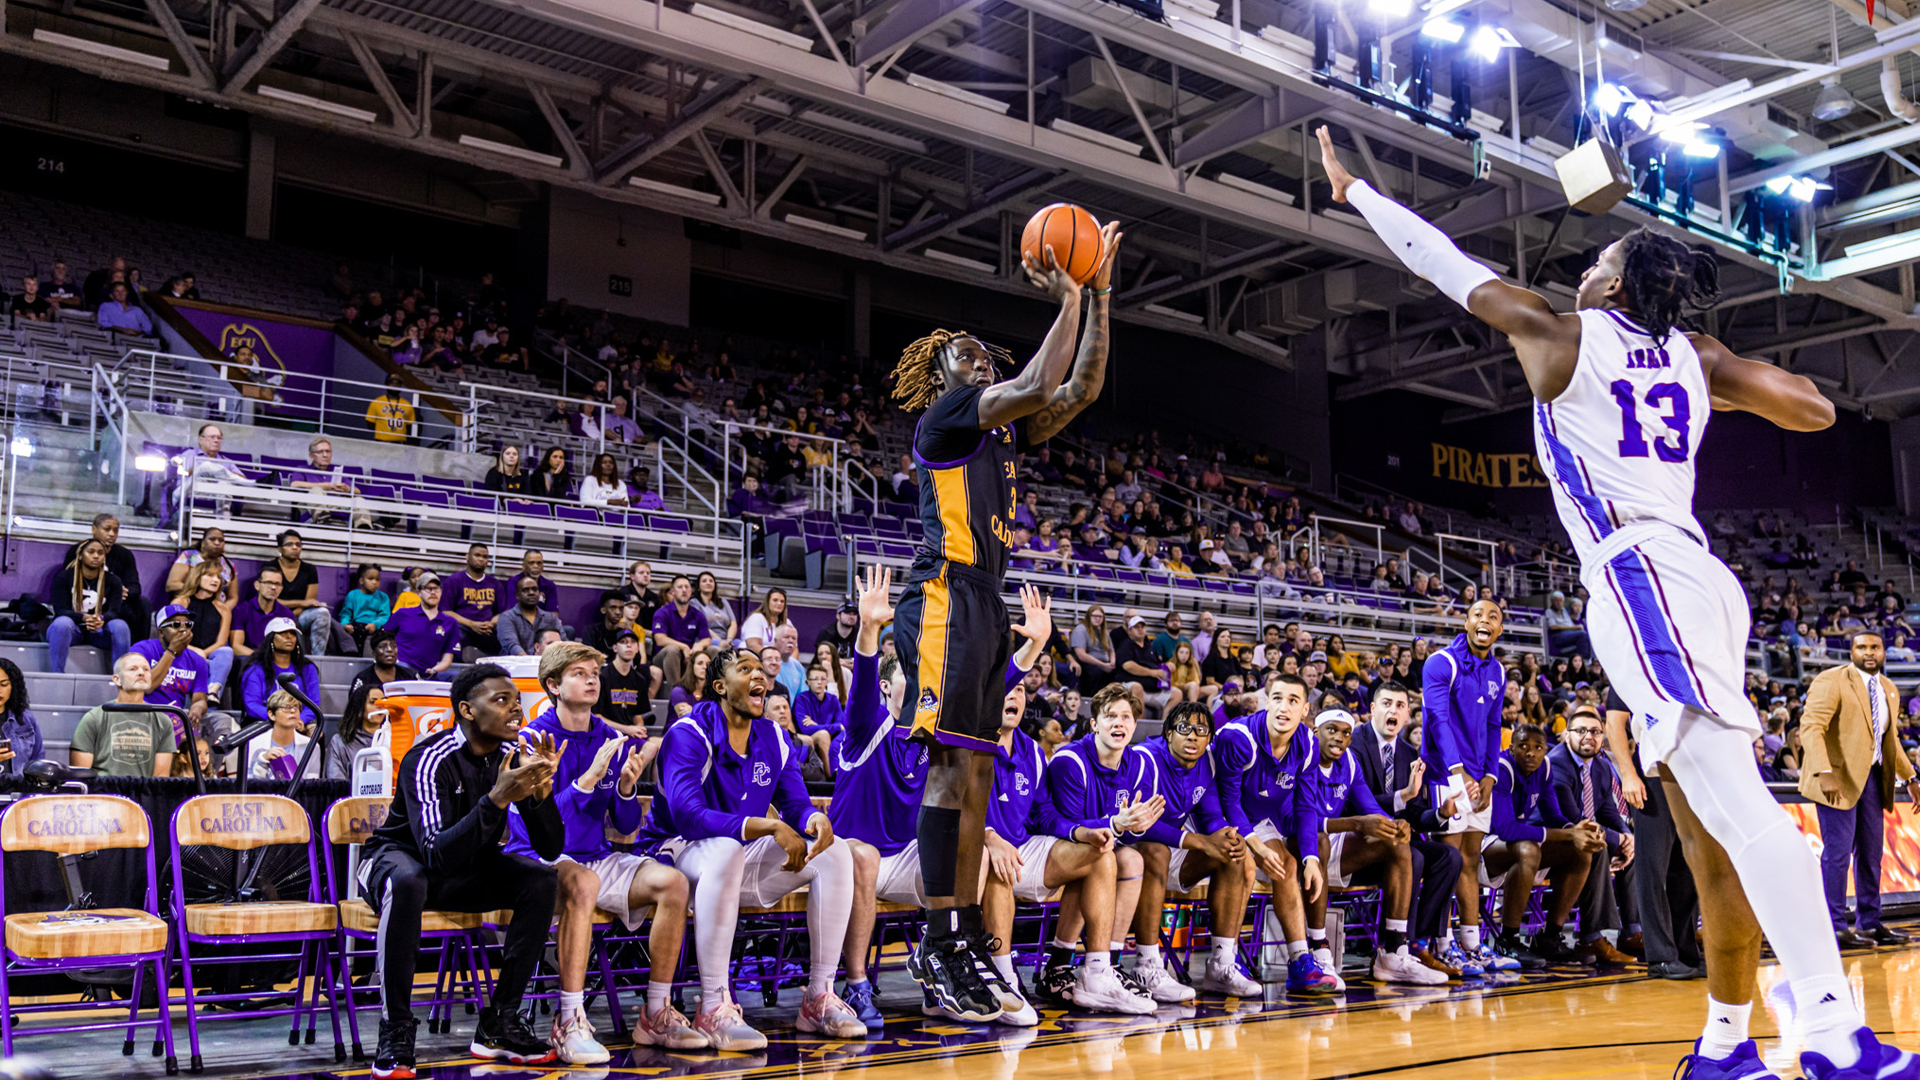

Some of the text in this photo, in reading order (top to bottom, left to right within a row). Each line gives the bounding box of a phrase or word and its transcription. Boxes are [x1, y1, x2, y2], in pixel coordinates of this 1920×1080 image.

[38, 157, 65, 173] 214
[230, 336, 256, 349] ECU
[1610, 379, 1690, 463] 13
[1387, 455, 1400, 466] 201
[1431, 442, 1549, 488] PIRATES
[463, 587, 495, 602] PIRATES
[1024, 708, 1041, 720] ECU
[360, 784, 383, 795] GATORADE
[52, 803, 98, 819] EAST
[221, 802, 264, 818] EAST
[369, 804, 388, 820] EA
[28, 818, 123, 837] CAROLINA
[200, 816, 286, 833] CAROLINA
